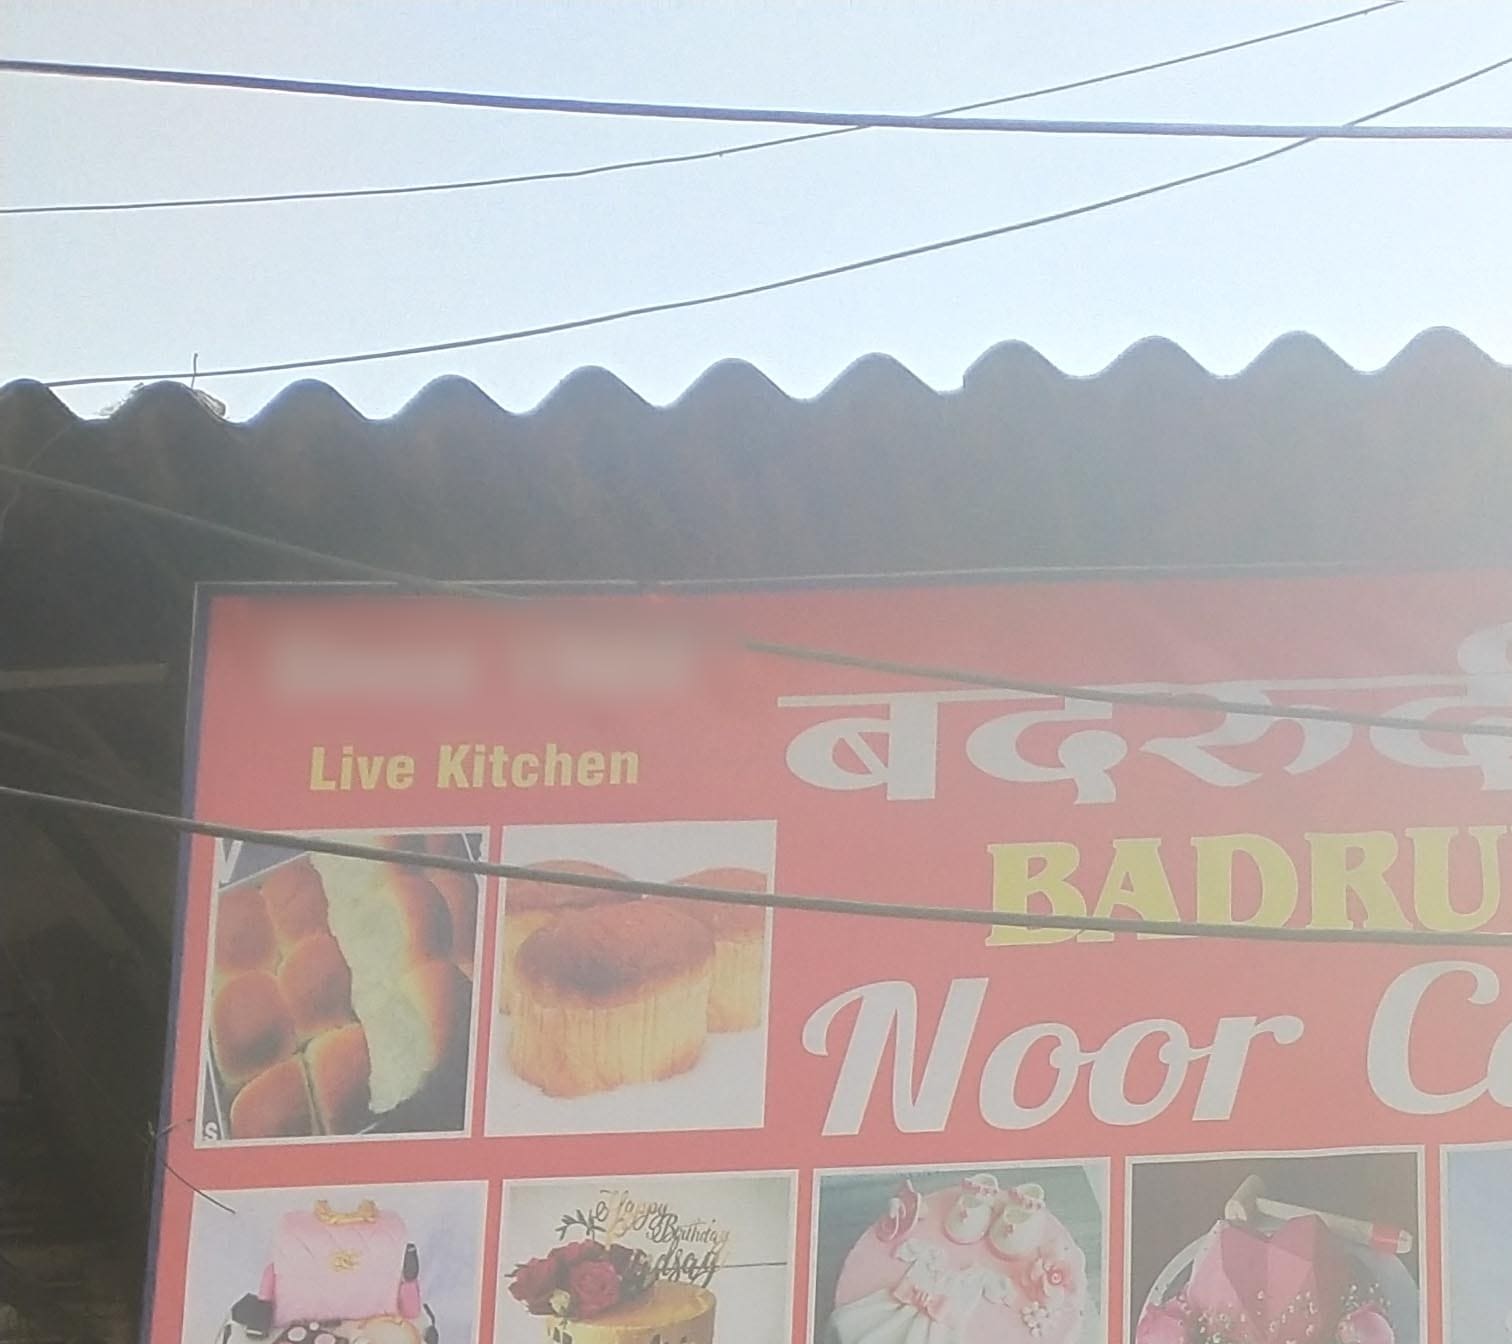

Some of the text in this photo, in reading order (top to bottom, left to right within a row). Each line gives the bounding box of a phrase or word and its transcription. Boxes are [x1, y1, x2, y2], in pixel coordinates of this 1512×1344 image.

[311, 743, 640, 792] Live Kitchen
[803, 977, 1303, 1137] Noor
